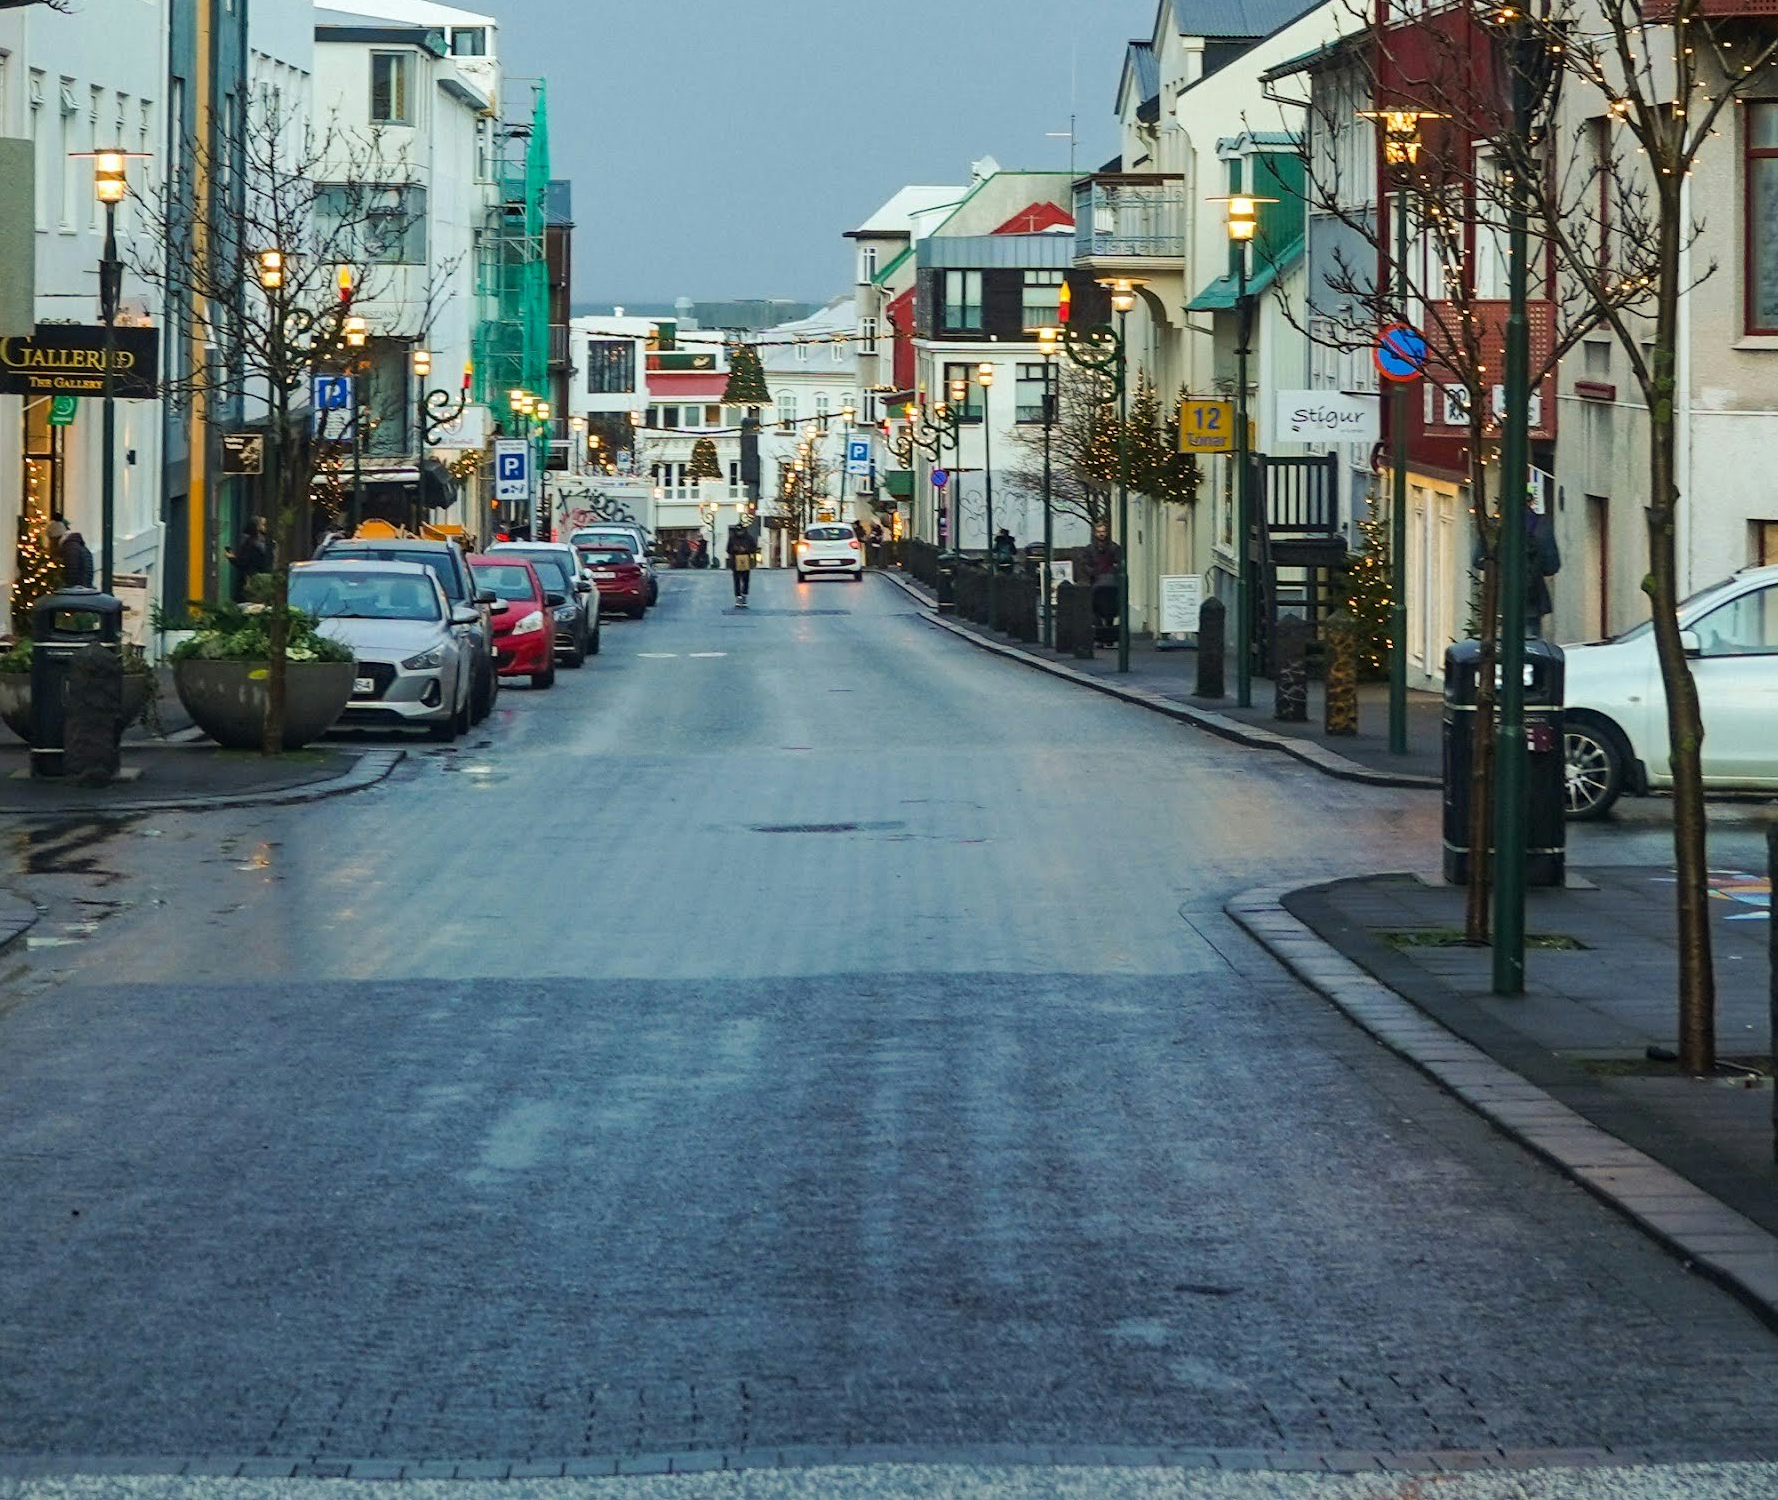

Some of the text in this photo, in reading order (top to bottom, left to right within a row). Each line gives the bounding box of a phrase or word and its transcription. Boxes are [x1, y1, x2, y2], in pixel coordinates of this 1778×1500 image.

[29, 376, 105, 389] THE GALLERY
[1194, 407, 1221, 429] 12
[1291, 406, 1365, 429] Stígur
[854, 446, 865, 458] P
[504, 458, 520, 476] P
